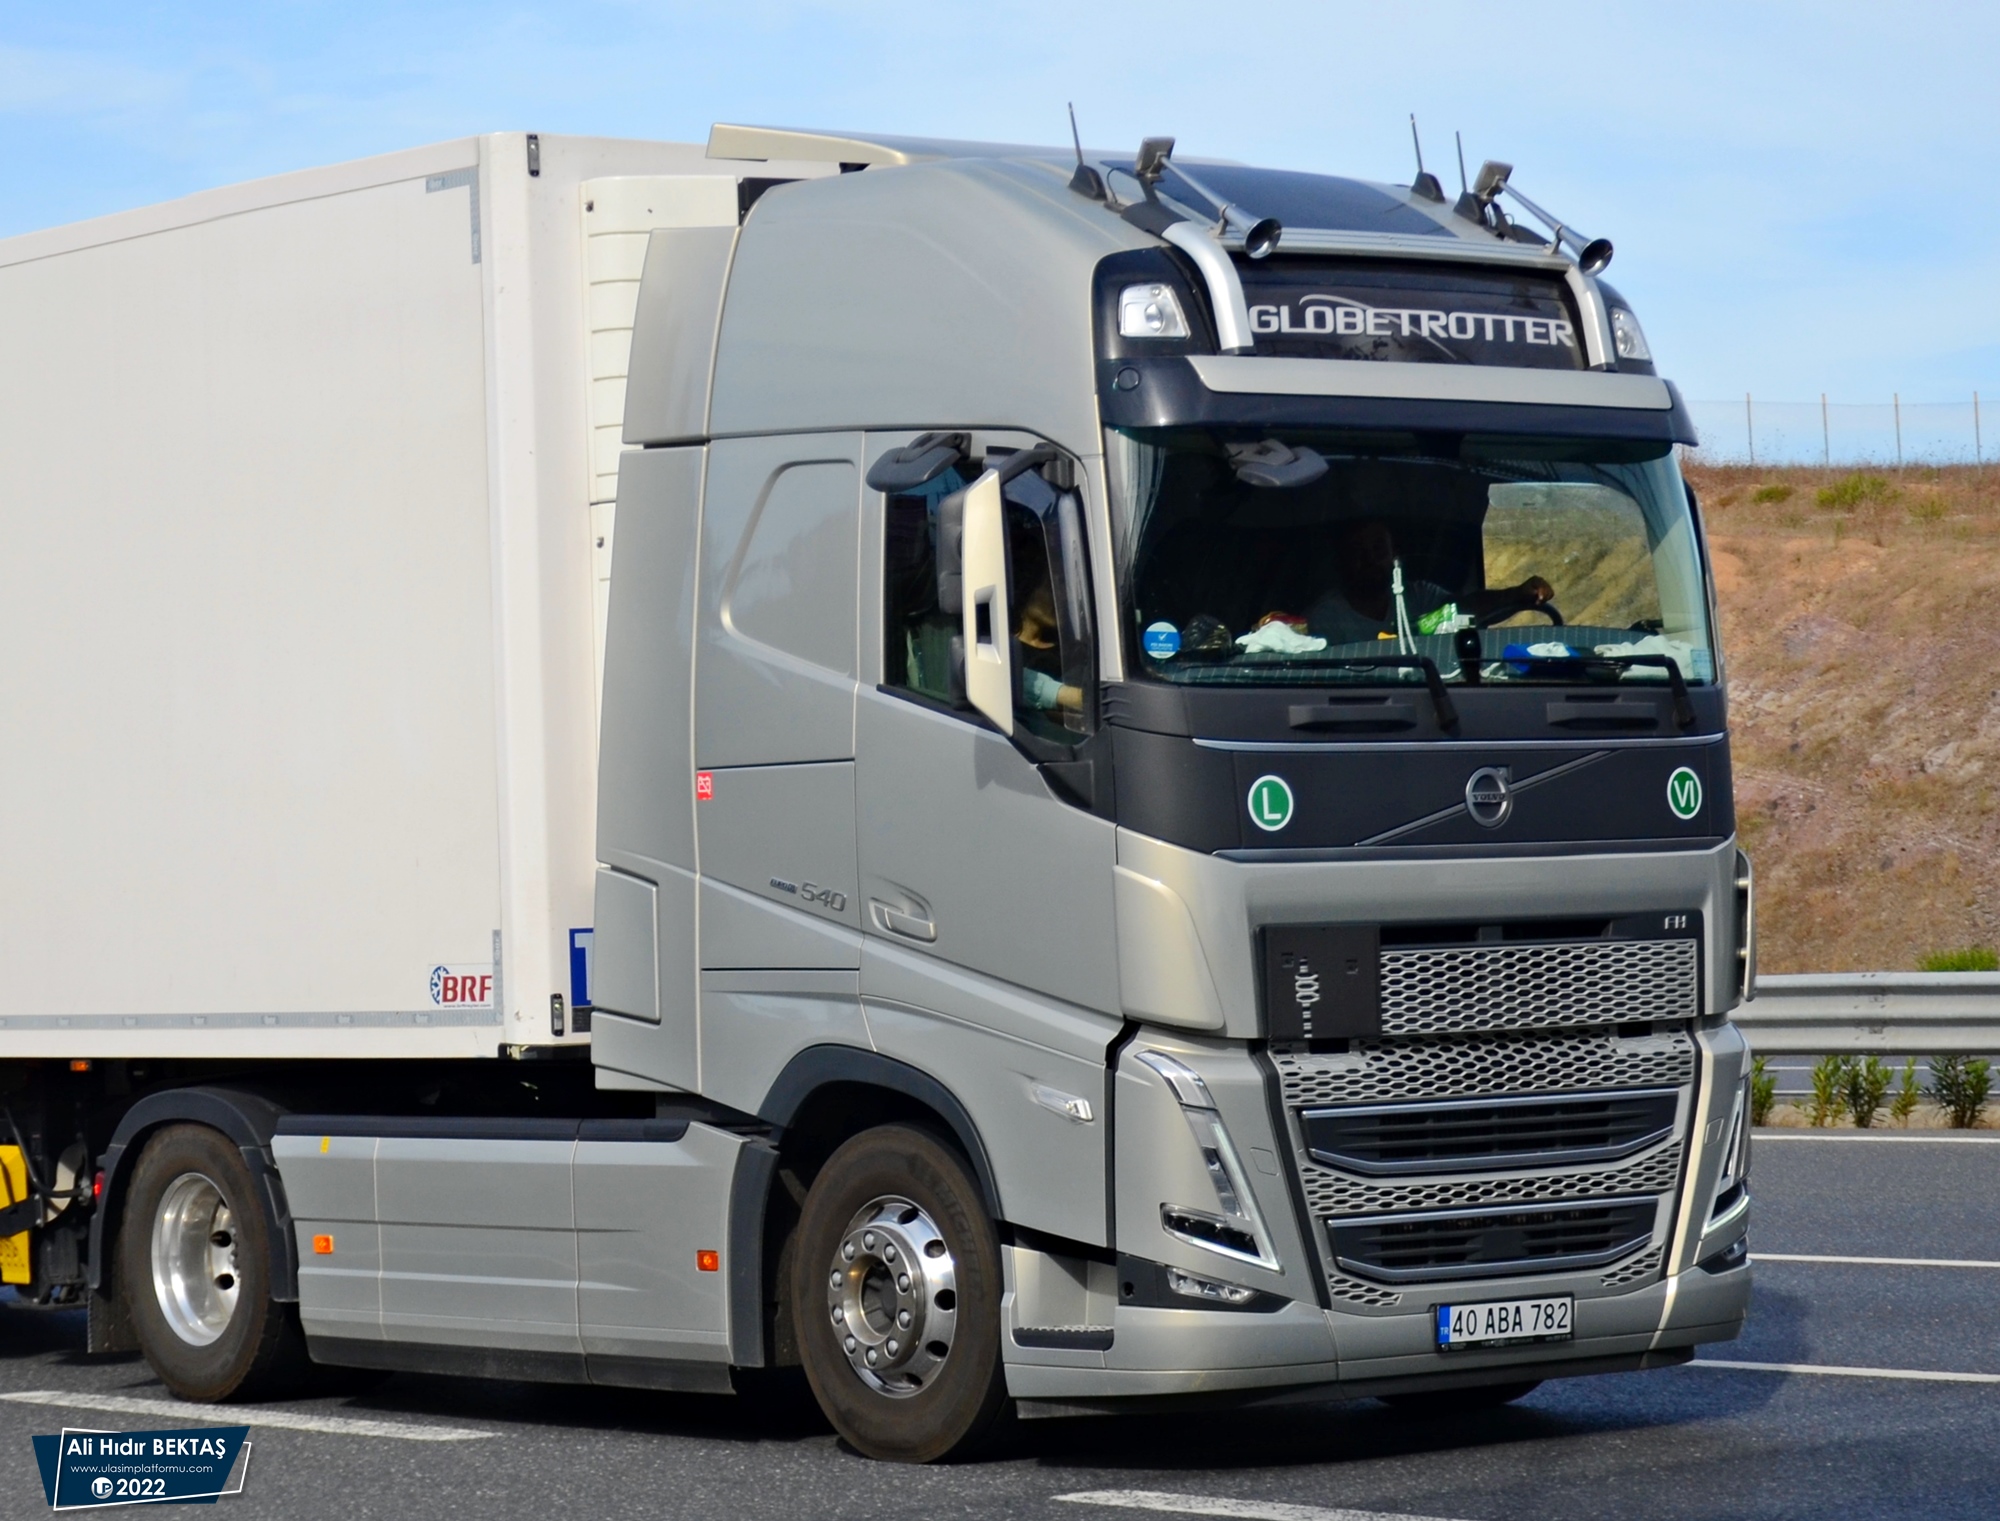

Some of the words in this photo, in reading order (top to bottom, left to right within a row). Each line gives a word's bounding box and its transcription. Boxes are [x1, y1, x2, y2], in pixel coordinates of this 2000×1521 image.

[1249, 304, 1575, 347] GLOBETROTTER
[1262, 787, 1282, 820] L
[1473, 793, 1506, 802] VOLVO
[801, 881, 847, 912] 540
[1664, 914, 1687, 930] FH
[442, 975, 493, 1003] BRF
[1440, 1327, 1450, 1336] TR
[1452, 1309, 1478, 1337] 40
[1484, 1305, 1523, 1335] ABA
[1530, 1302, 1569, 1331] 782
